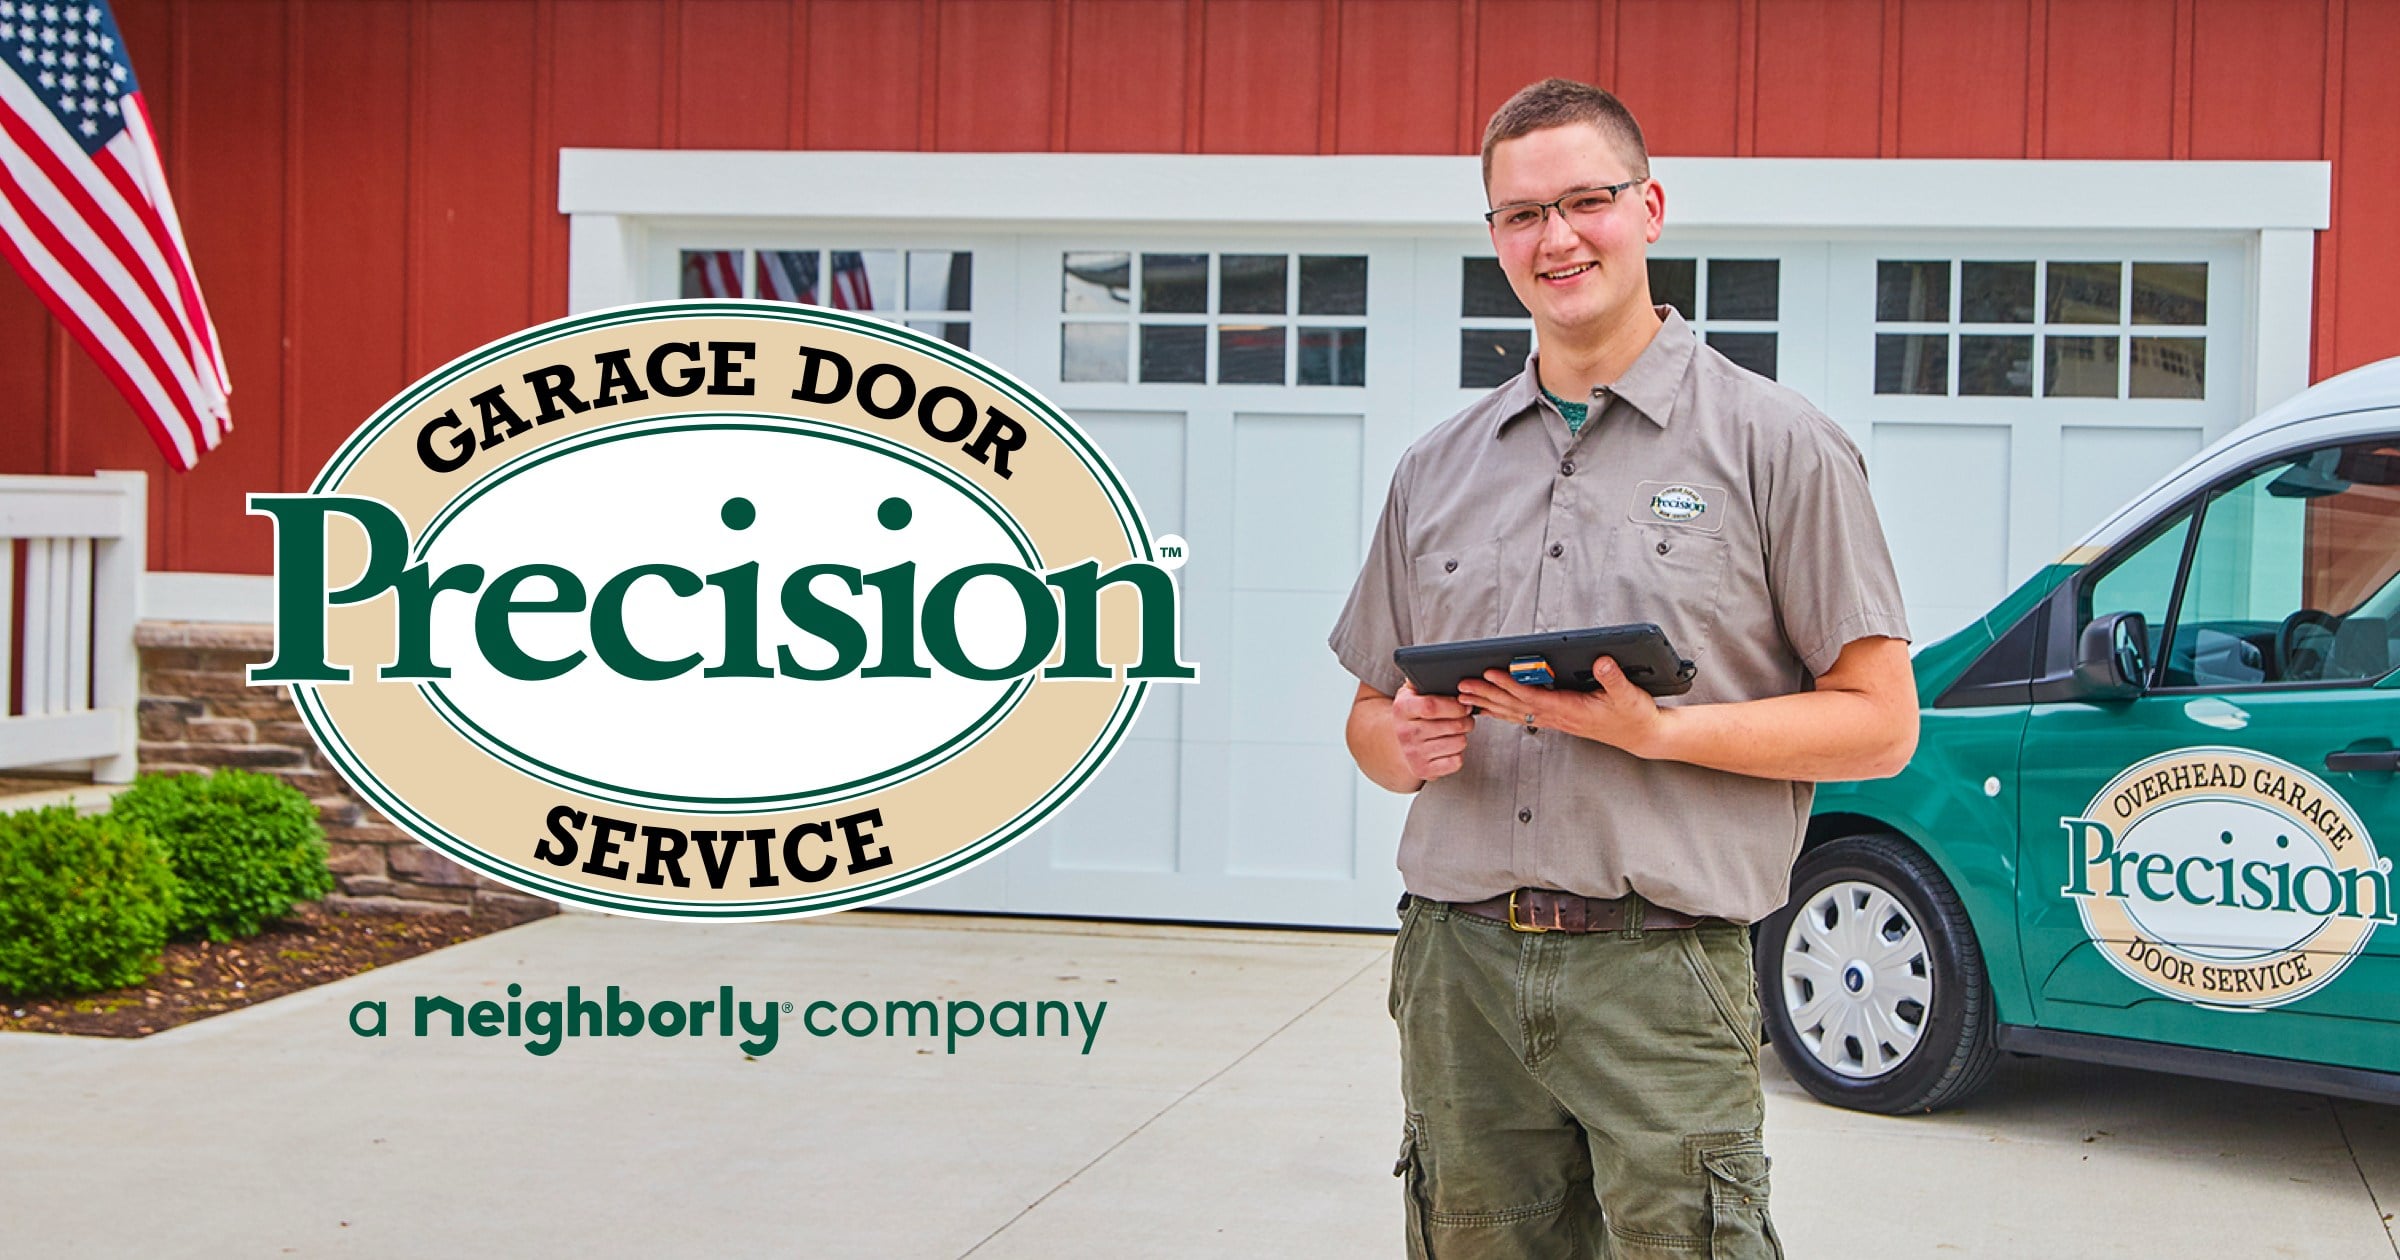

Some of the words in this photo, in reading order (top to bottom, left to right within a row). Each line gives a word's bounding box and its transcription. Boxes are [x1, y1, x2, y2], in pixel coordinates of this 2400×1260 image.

[2113, 763, 2247, 819] OVERHEAD
[2253, 768, 2353, 851] GARAGE
[2063, 820, 2395, 921] Precision
[2125, 936, 2196, 987] DOOR
[2202, 952, 2313, 992] SERVICE
